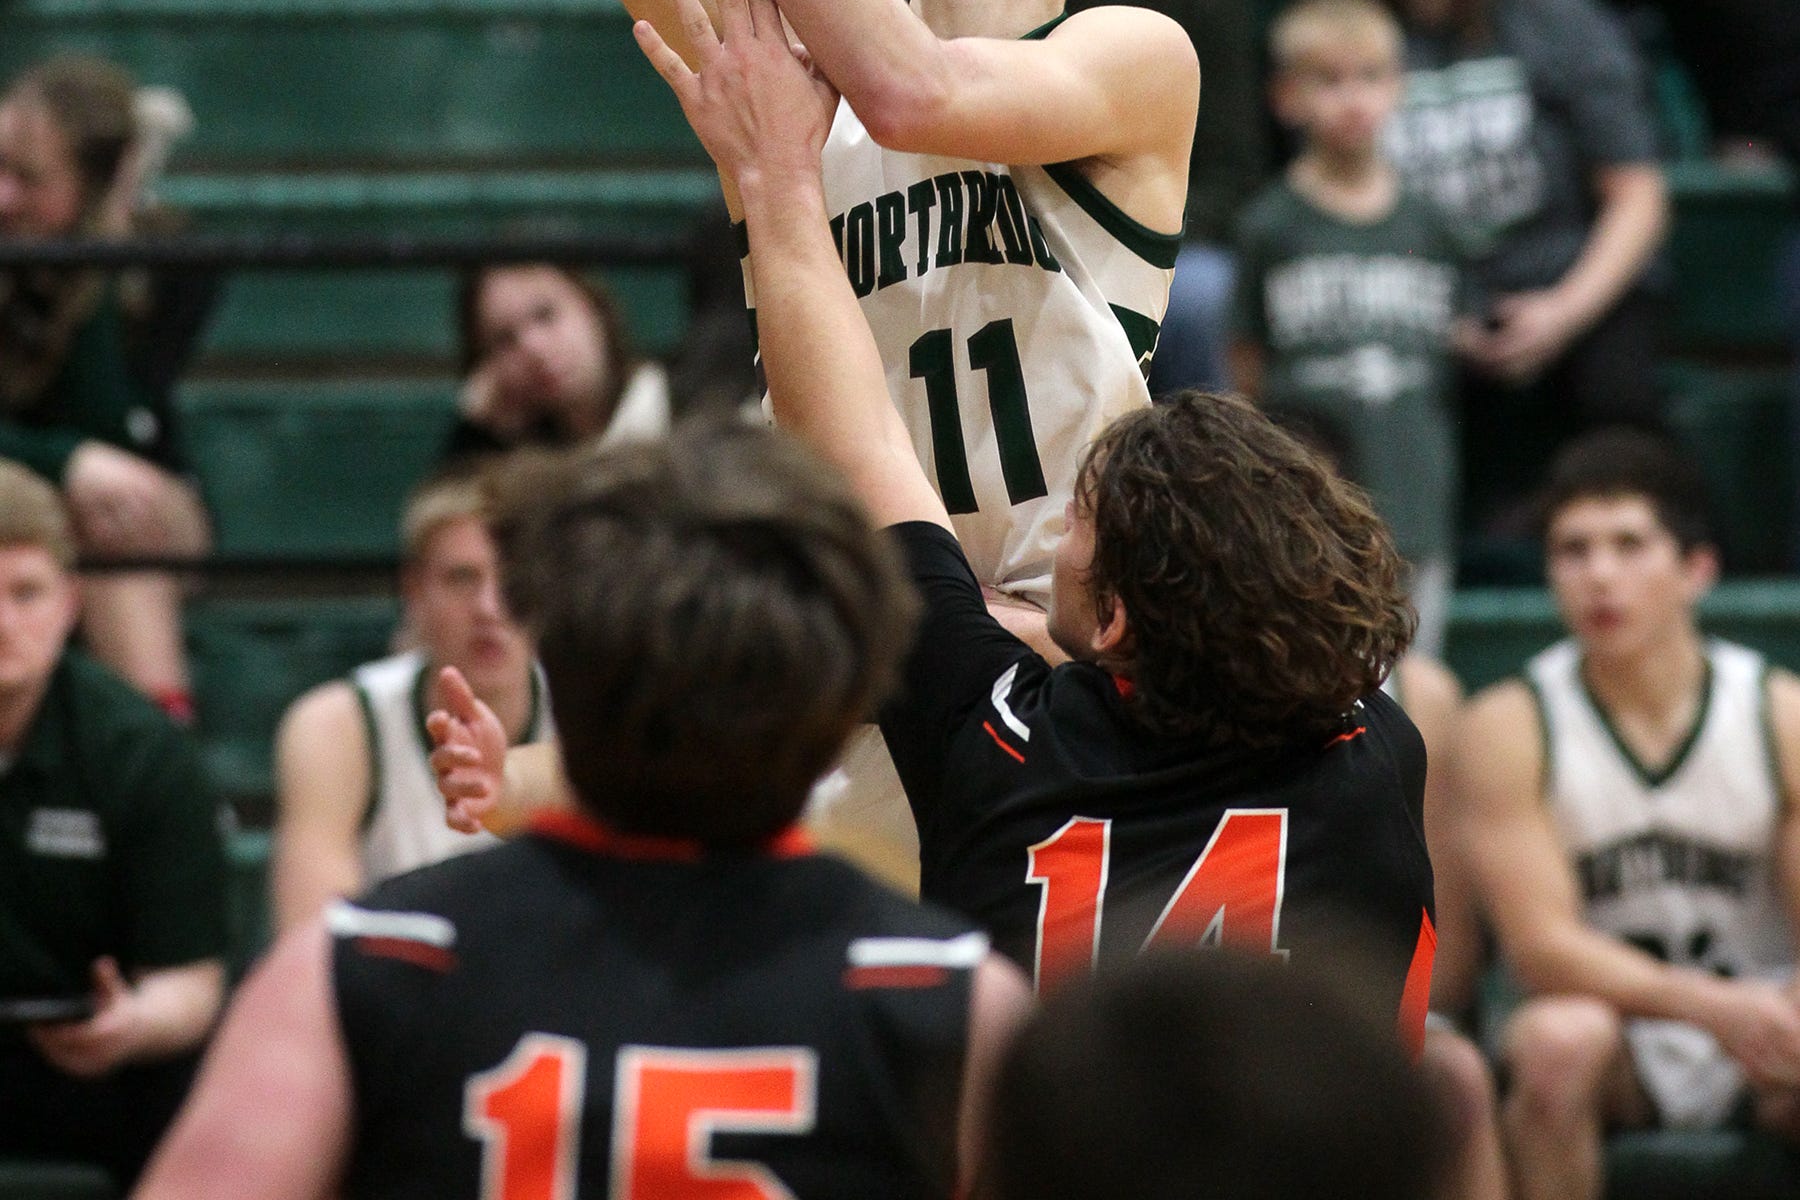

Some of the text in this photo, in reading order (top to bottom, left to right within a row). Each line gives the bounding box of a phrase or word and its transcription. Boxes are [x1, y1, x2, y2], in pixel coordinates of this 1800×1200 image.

[908, 317, 1049, 516] 11
[1025, 807, 1291, 1000] 14
[460, 1030, 820, 1200] 15
